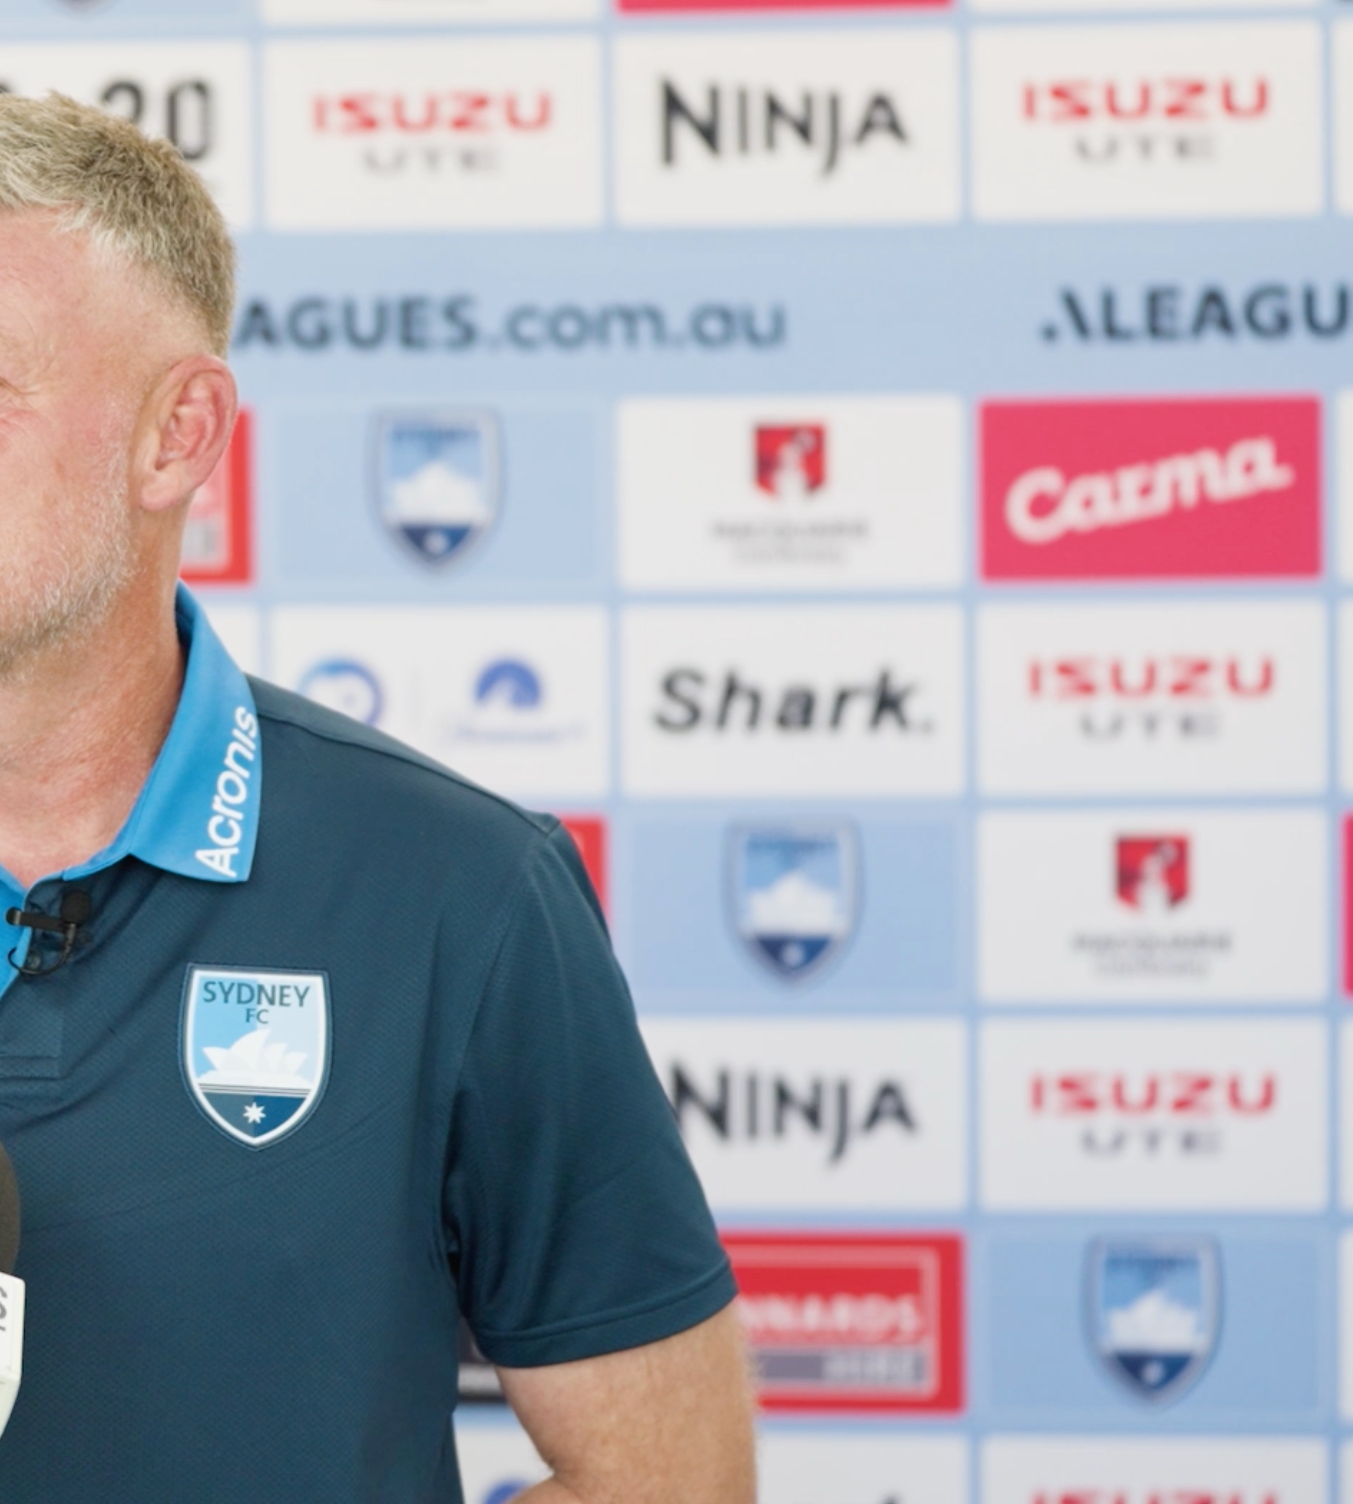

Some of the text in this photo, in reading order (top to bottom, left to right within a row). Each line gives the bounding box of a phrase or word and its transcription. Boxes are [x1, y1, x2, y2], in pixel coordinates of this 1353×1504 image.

[314, 92, 551, 133] ISUZU
[1023, 77, 1269, 121] ISUZU
[661, 78, 909, 178] NINJA
[237, 296, 785, 351] AGUES.com.au
[1005, 436, 1293, 544] Carma
[1029, 656, 1274, 698] ISUZU
[195, 706, 258, 878] Acronis
[203, 981, 310, 1007] SYDNEY
[245, 1008, 269, 1024] FC
[671, 1066, 917, 1166] NINJA
[1031, 1074, 1277, 1114] ISUZU
